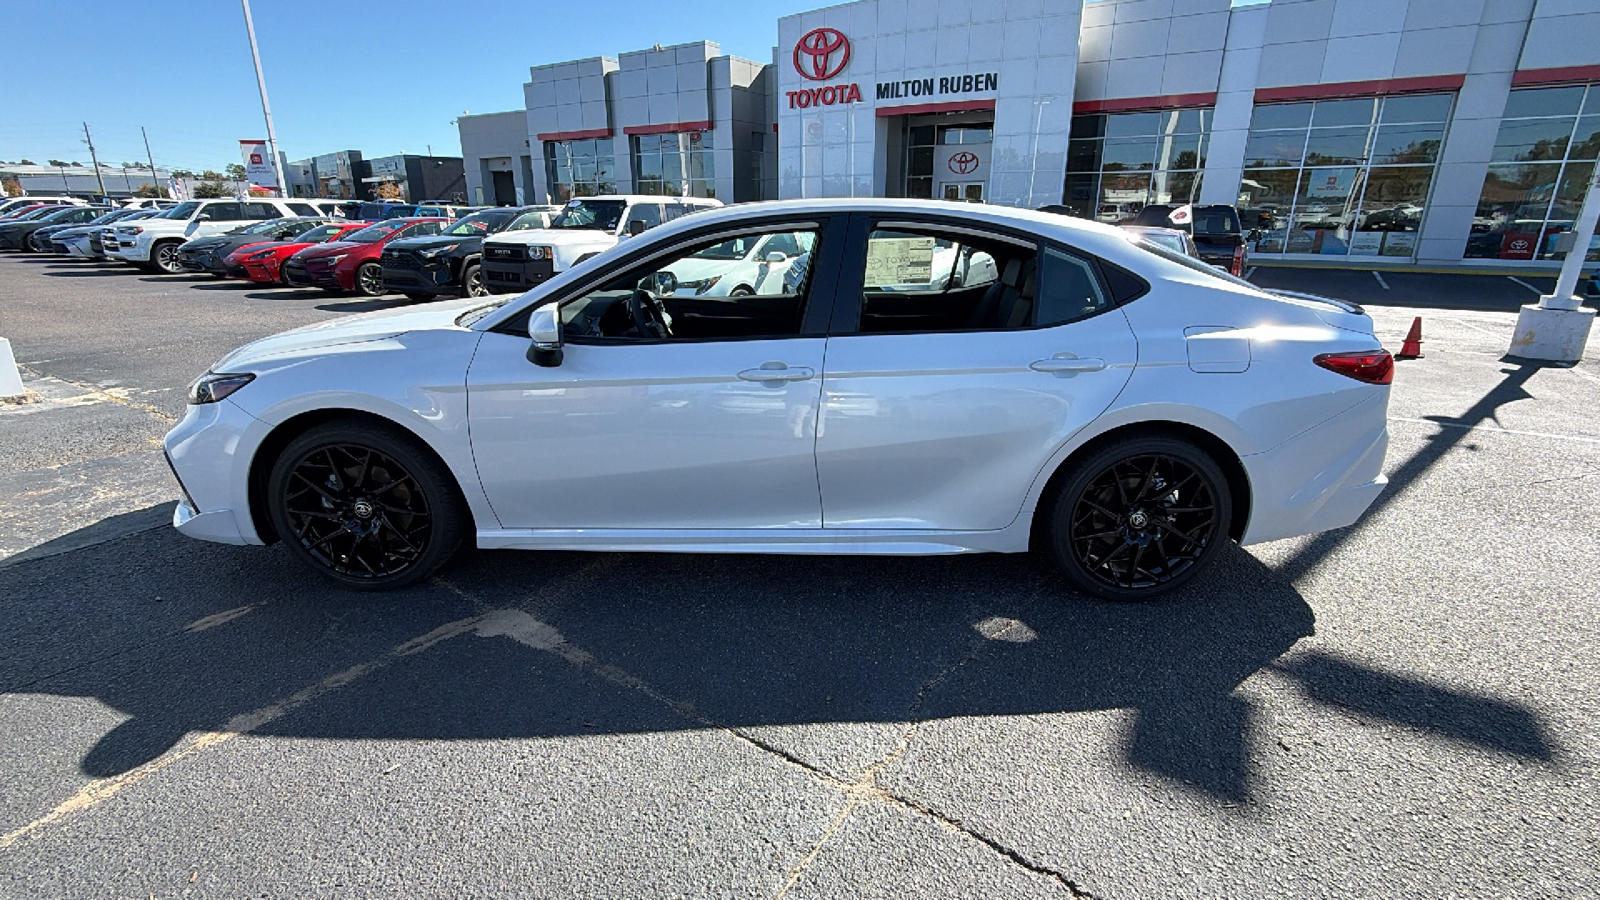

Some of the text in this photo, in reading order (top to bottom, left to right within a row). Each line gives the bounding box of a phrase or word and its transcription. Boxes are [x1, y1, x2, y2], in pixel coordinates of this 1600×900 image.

[786, 83, 862, 109] TOYOTA
[876, 73, 998, 100] MILTON RUBEN
